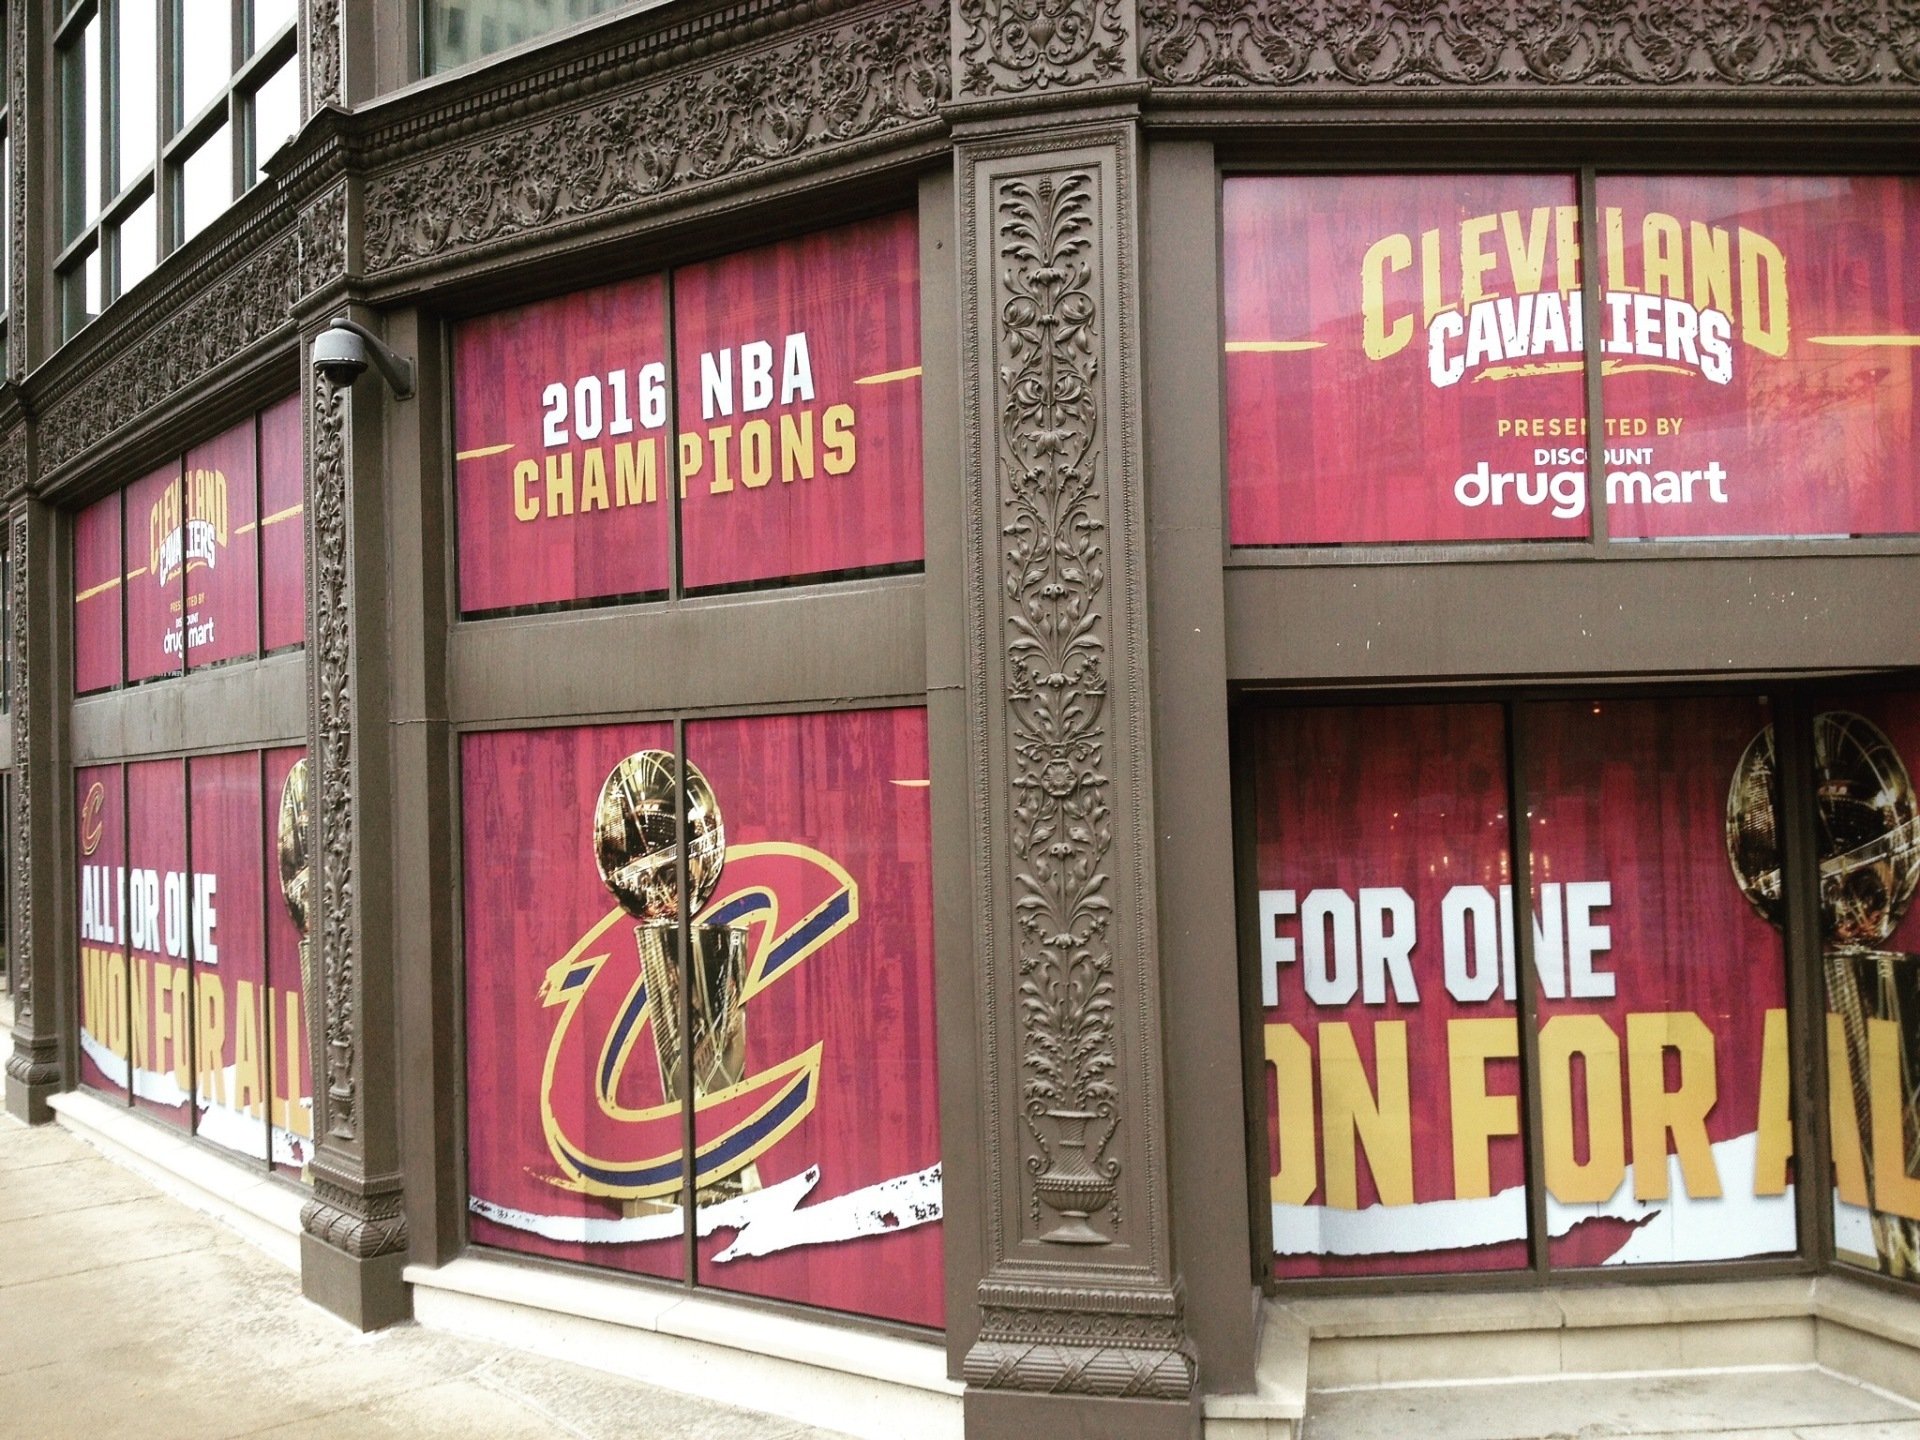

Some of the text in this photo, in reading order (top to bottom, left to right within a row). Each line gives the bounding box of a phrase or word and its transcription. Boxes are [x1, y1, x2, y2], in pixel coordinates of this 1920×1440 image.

[542, 331, 815, 448] 2016 NBA
[1656, 418, 1683, 435] BY
[513, 403, 856, 522] CHAMPIONS
[1454, 461, 1728, 519] drug mart
[150, 468, 228, 575] CLEVLAND
[160, 519, 216, 588] CAVAIERS
[82, 865, 115, 944] ALL
[164, 871, 218, 964] ONE
[1259, 881, 1616, 1006] FOR ONE
[81, 946, 311, 1139] WON FOR ALL
[1447, 1011, 1722, 1205] FOR
